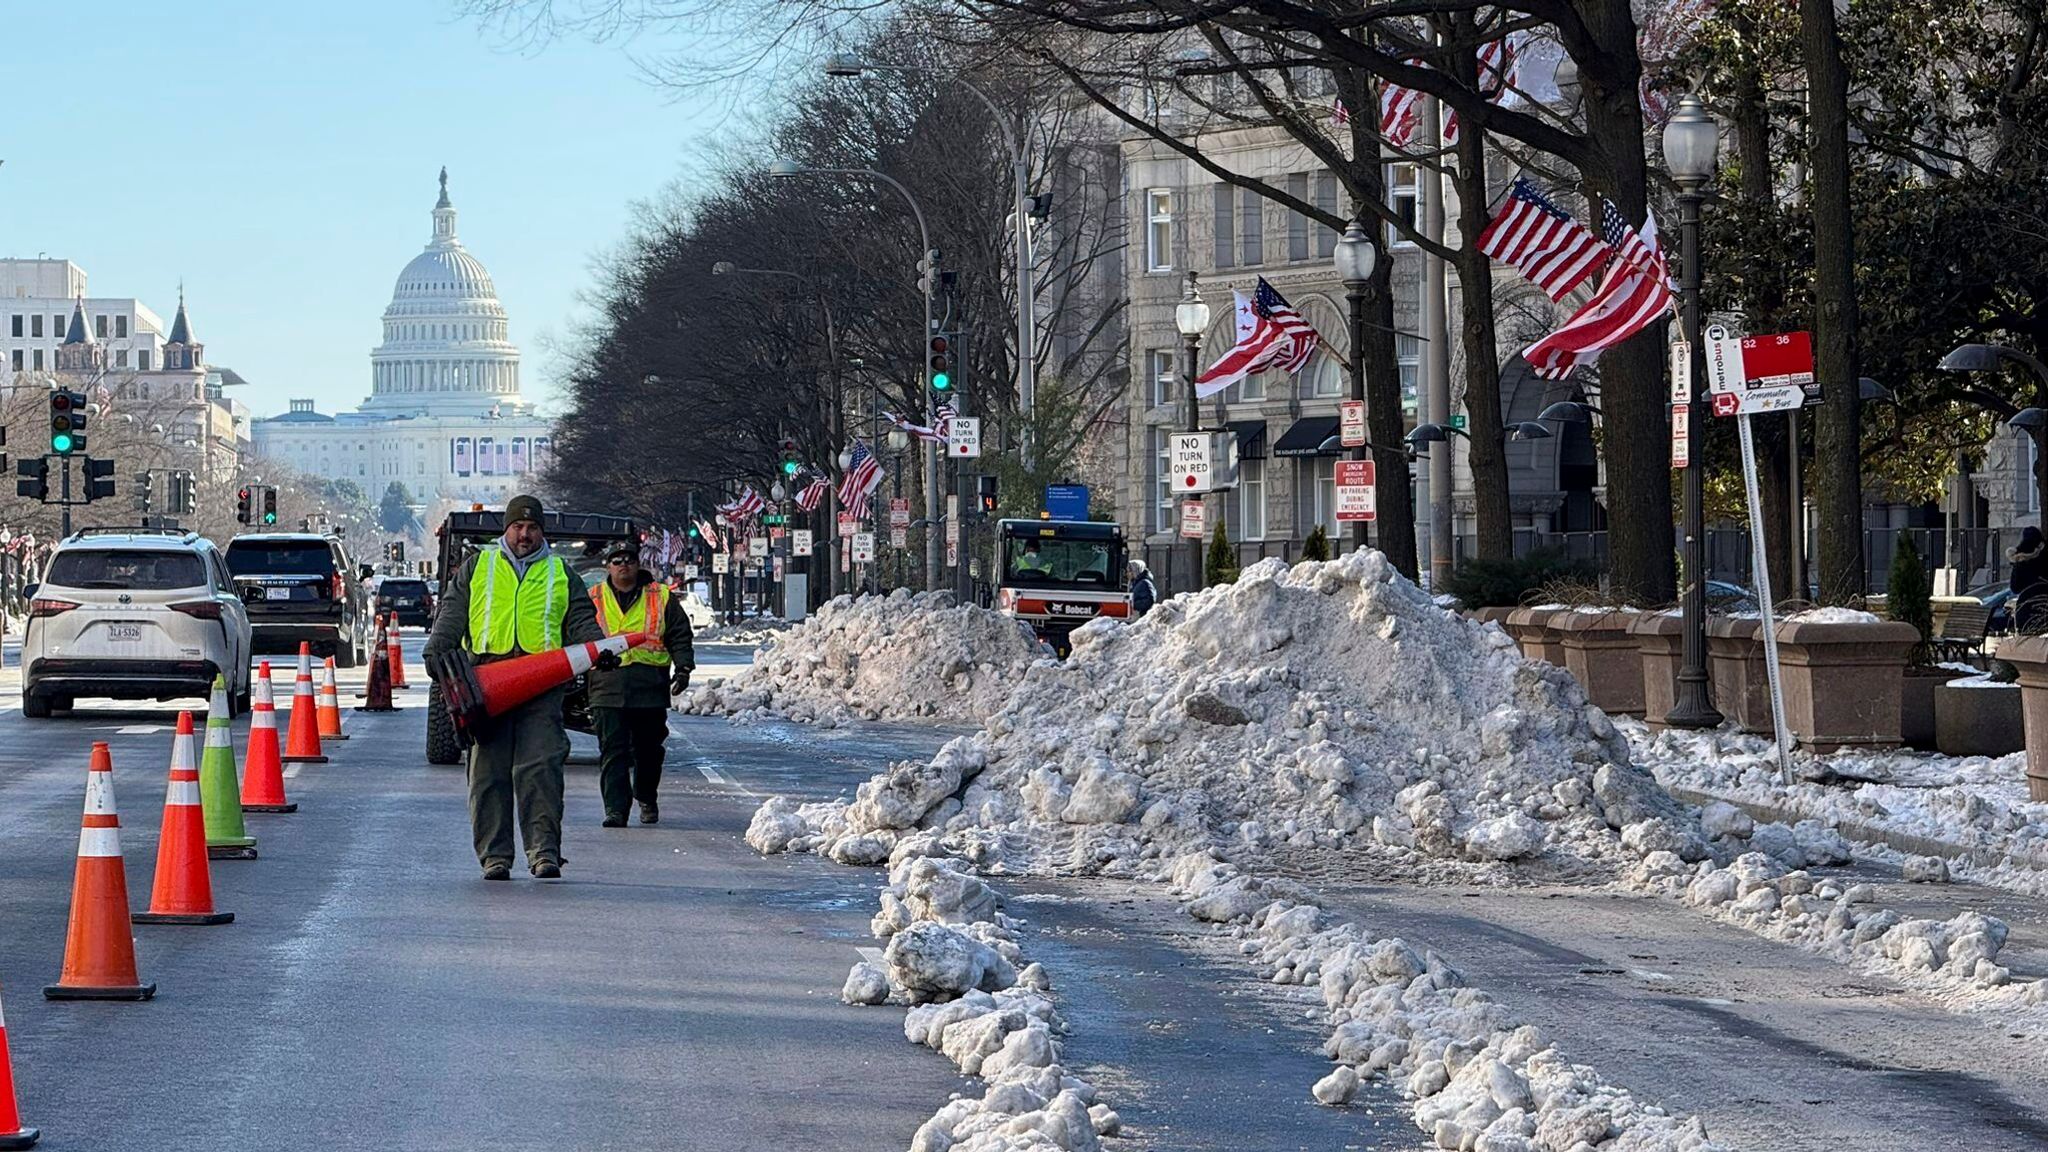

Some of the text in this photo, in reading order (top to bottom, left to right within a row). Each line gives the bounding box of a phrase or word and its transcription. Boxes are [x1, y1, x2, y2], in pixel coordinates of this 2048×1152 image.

[1743, 335, 1790, 349] 32 36
[1713, 342, 1726, 391] metrobus
[1745, 388, 1791, 401] Commuter
[1774, 399, 1792, 409] Bus
[957, 420, 970, 428] NO
[1181, 438, 1199, 449] NO
[1179, 451, 1203, 461] TURN
[1173, 463, 1208, 474] ON RED
[1346, 463, 1364, 471] SNOW
[1345, 477, 1365, 485] ROUTE
[985, 497, 993, 509] 4
[1341, 503, 1370, 511] EMERGENCY
[1065, 605, 1092, 615] Bobcat
